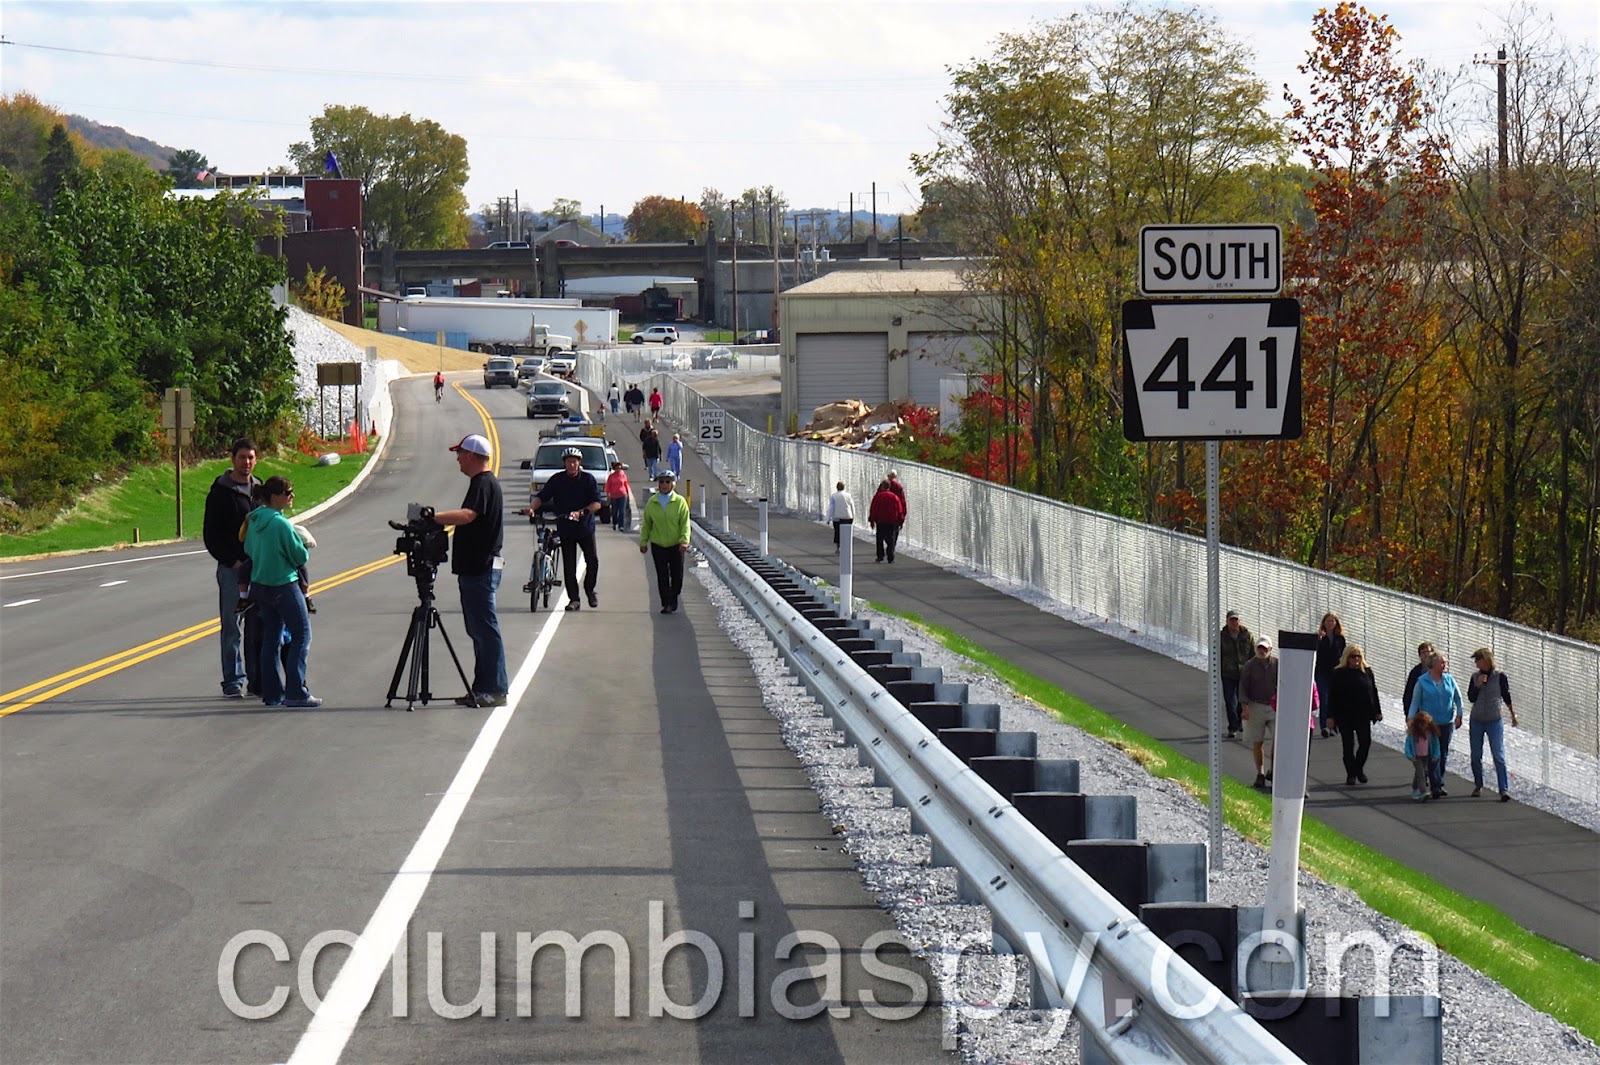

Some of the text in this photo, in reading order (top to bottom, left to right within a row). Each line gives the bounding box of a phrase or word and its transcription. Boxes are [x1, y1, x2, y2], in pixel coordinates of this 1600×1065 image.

[1153, 237, 1270, 280] SOUTH
[1142, 337, 1278, 409] 441
[701, 426, 723, 439] 25
